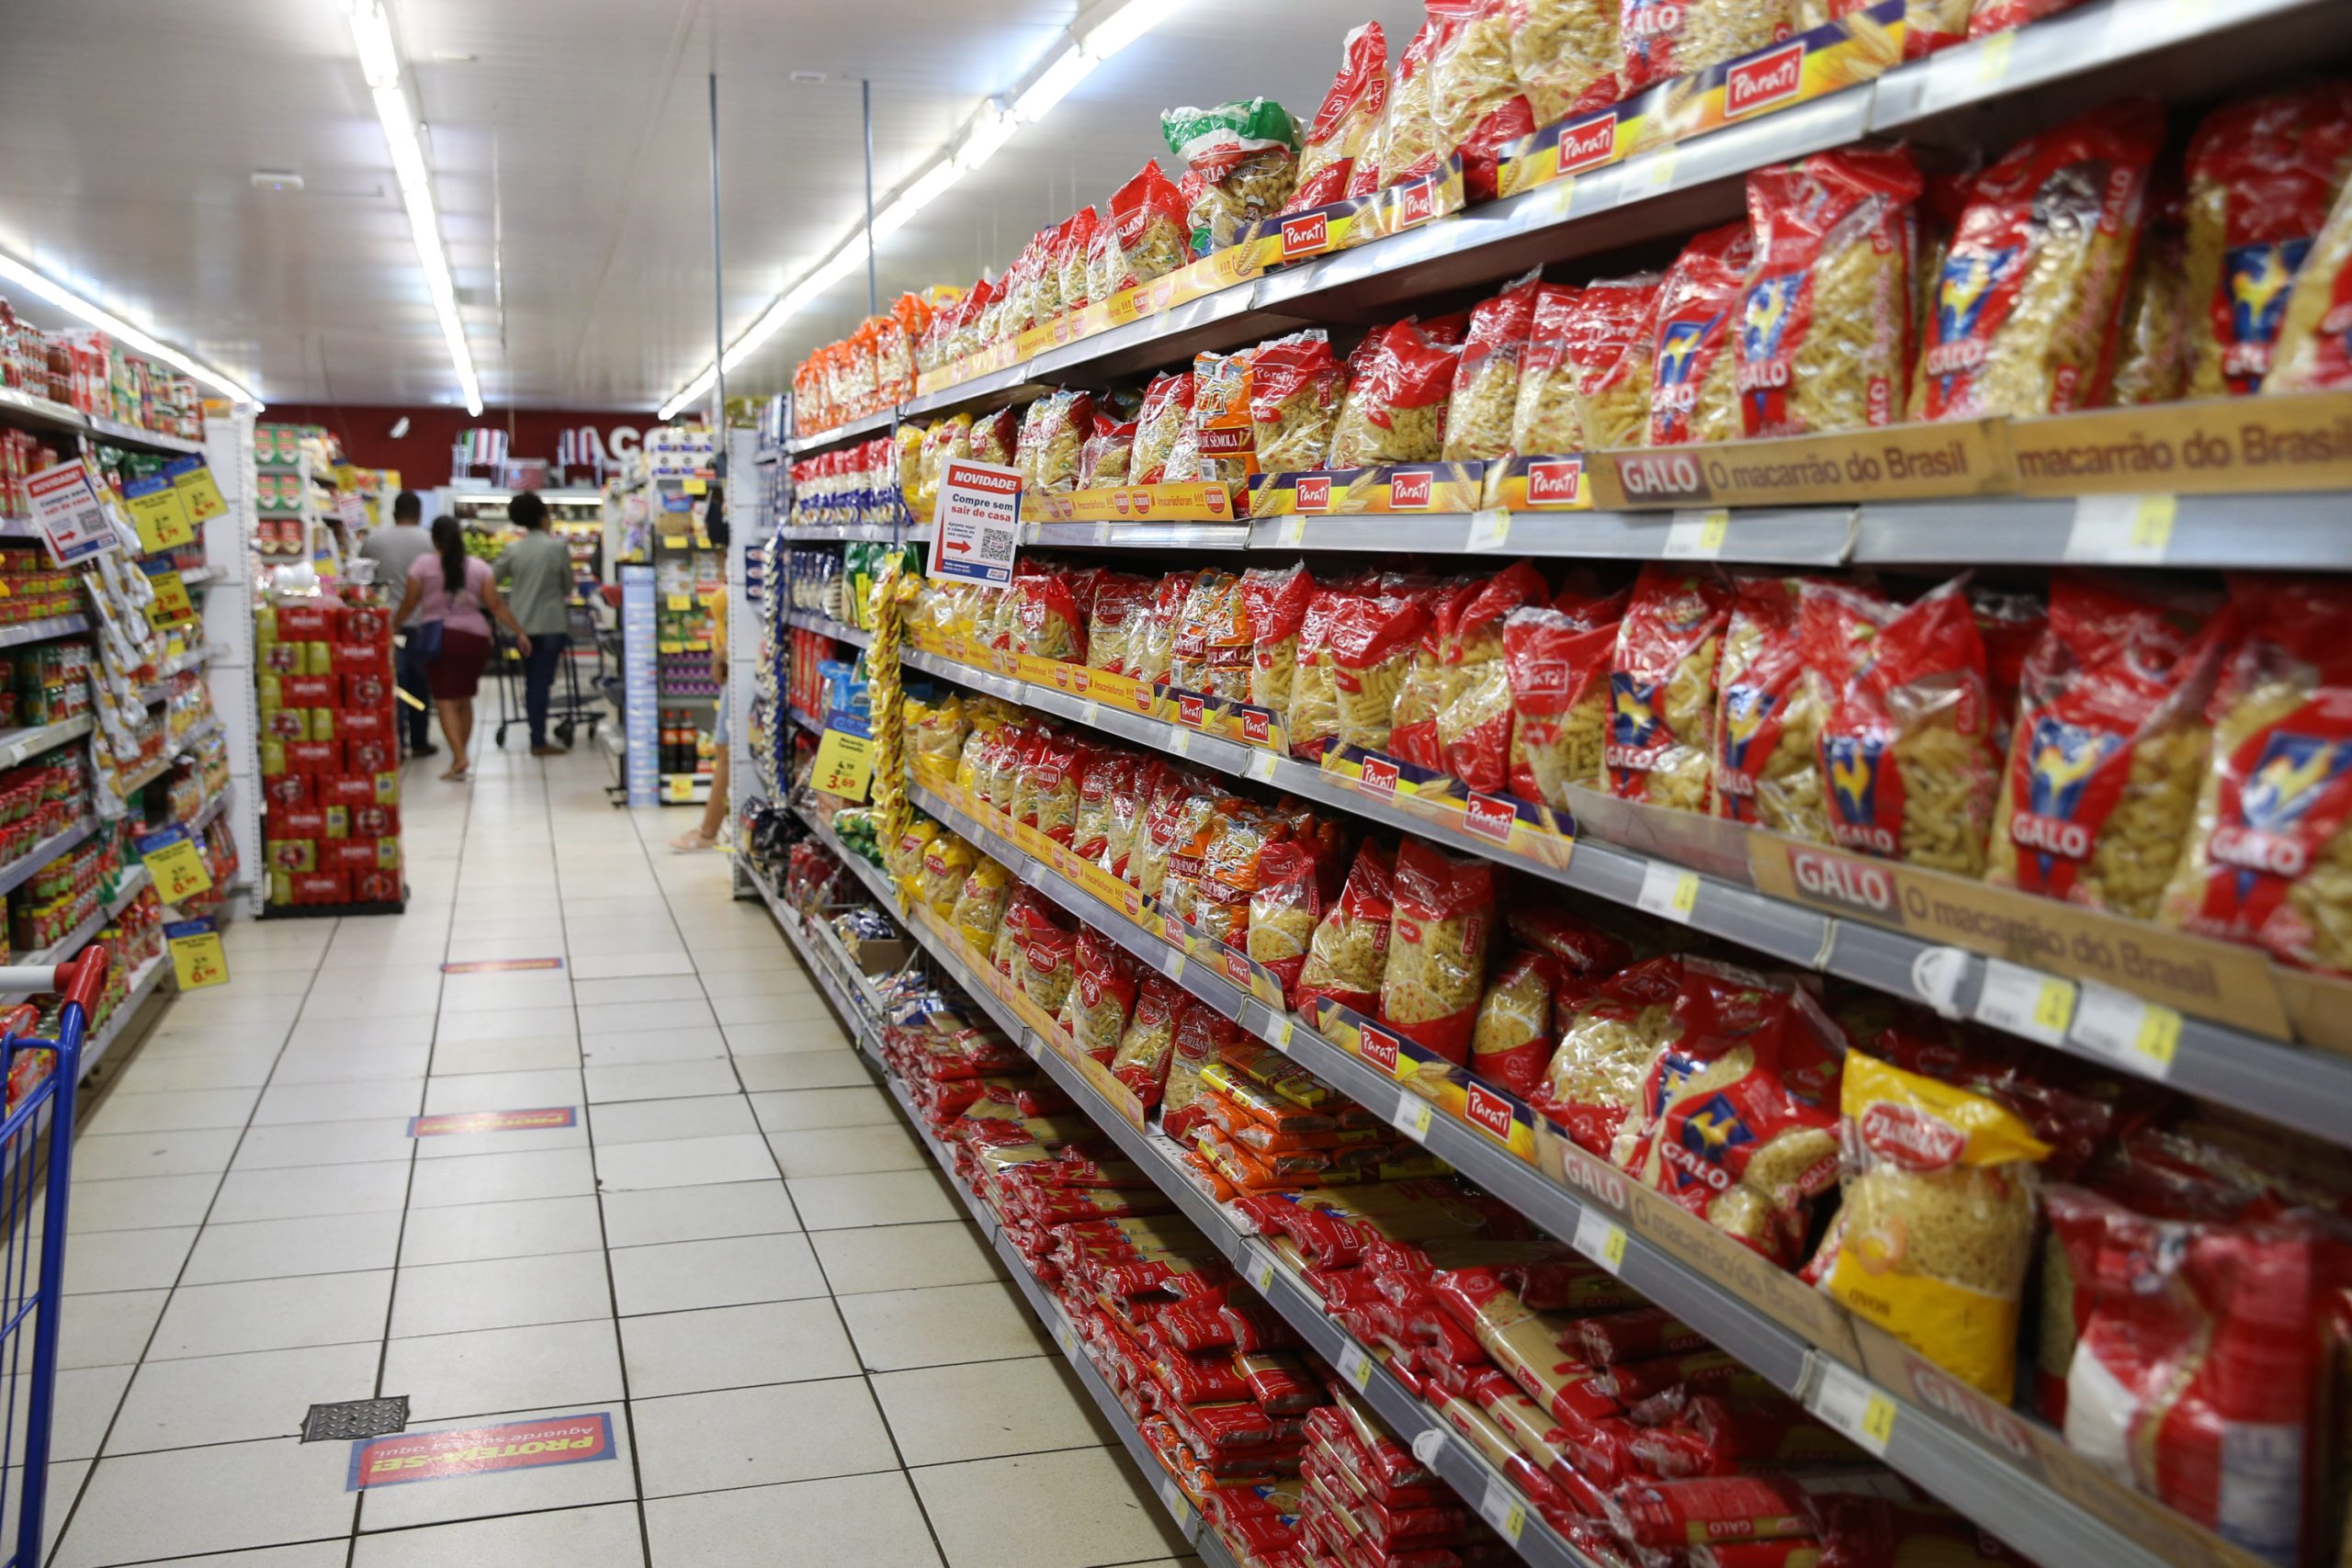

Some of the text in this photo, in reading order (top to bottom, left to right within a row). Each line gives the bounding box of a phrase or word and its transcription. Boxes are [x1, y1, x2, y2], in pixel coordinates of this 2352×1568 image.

[1624, 6, 1679, 39] ALO
[1733, 55, 1796, 102] Parati
[1564, 127, 1612, 160] Parati
[1285, 221, 1325, 246] Parati
[1738, 363, 1789, 391] GALO
[1622, 441, 1968, 494] GALO O macarrão do Brasil
[2017, 434, 2172, 479] macarrão
[2183, 430, 2232, 469] do
[954, 470, 1017, 491] NOVIDADE!
[1298, 483, 1328, 502] Parati
[1394, 479, 1430, 500] Parati
[1530, 470, 1578, 494] Parati
[951, 505, 1012, 522] sair de casa
[952, 493, 1013, 512] Compre sem
[1181, 700, 1203, 723] Parati
[1244, 716, 1269, 739] Parati
[827, 774, 856, 790] 3,69
[1364, 764, 1397, 791] Parati
[1470, 798, 1514, 835] Parati
[2012, 818, 2089, 856] GALO
[1166, 918, 1185, 942] Parati
[1795, 853, 2219, 998] GALO O macarrão do Brasil
[1227, 955, 1250, 982] Parati
[1363, 1034, 1396, 1066] Parati
[1470, 1095, 1510, 1133] Parati
[1660, 1141, 1729, 1190] GALO
[1801, 1154, 1838, 1190] GALO
[1564, 1152, 1625, 1211] GALO
[1587, 1298, 1620, 1309] GALO
[511, 1426, 594, 1443] Aguarde
[369, 1436, 595, 1473] PROTEJA-SE!
[1710, 1520, 1751, 1534] GALO
